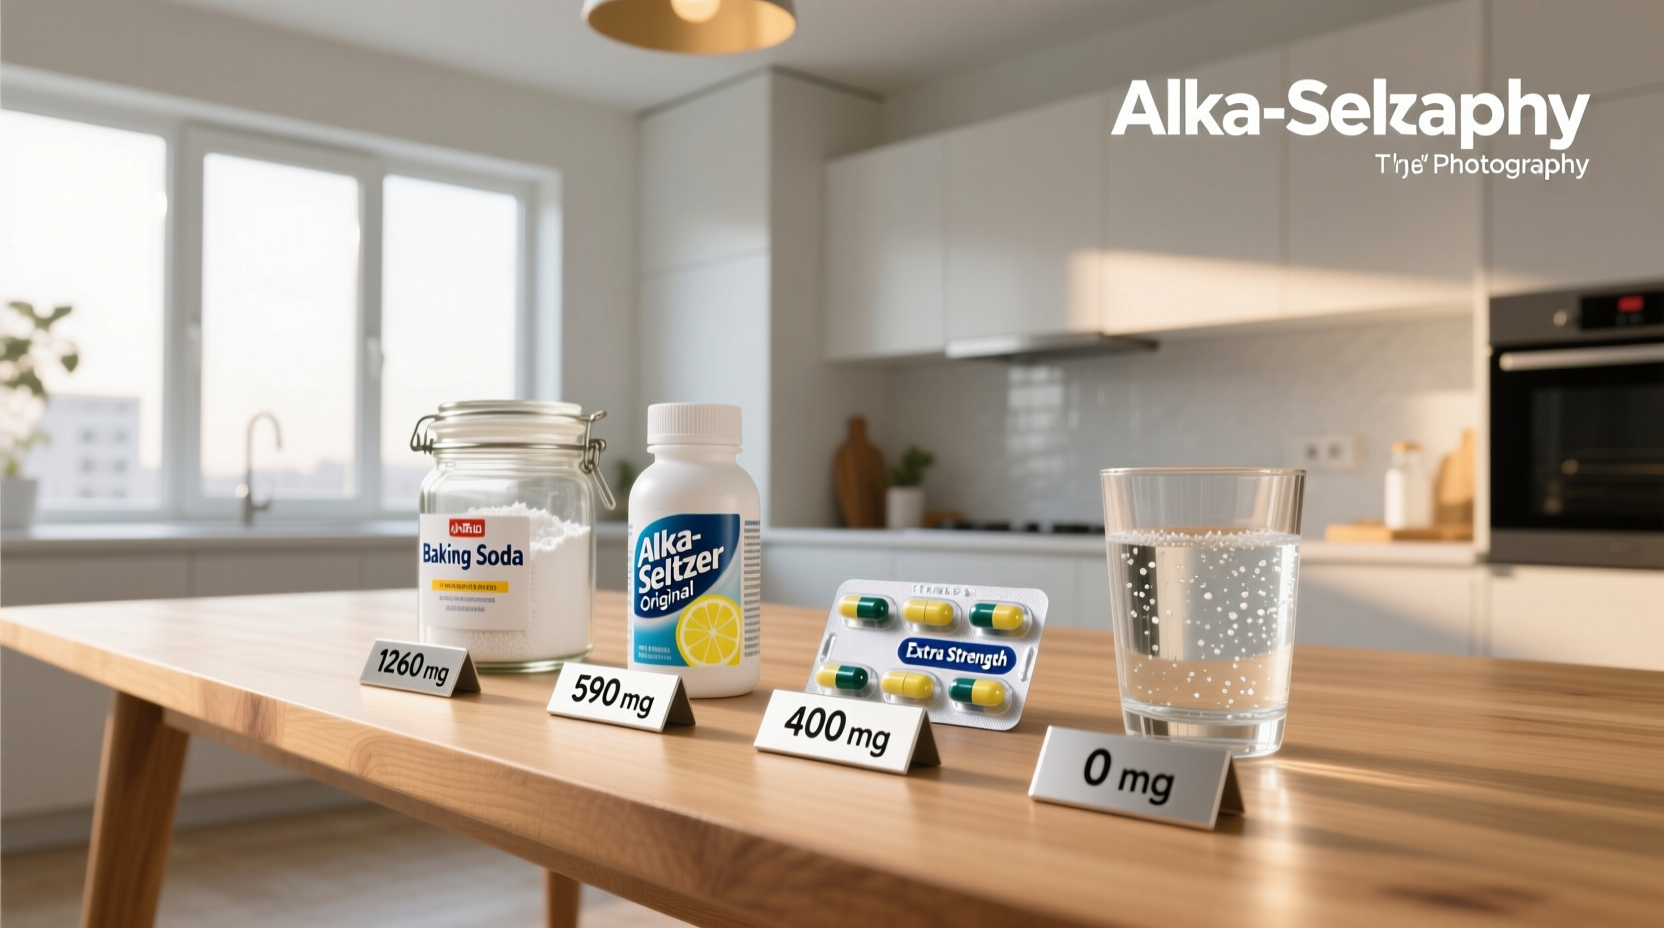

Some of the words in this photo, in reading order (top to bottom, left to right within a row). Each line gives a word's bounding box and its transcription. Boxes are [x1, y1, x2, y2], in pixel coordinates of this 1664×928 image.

[423, 542, 472, 571] Baking
[476, 543, 524, 567] Soda
[637, 529, 702, 568] Alka-
[638, 546, 725, 594] Seltzer
[640, 580, 694, 611] Original
[378, 648, 425, 677] 1260
[423, 665, 450, 687] mg
[906, 641, 944, 661] Extra
[946, 646, 1008, 670] Strength
[571, 674, 621, 706] 590
[619, 692, 655, 719] mg
[784, 705, 847, 742] 400
[847, 723, 891, 758] mg
[1083, 748, 1112, 786] 0
[1118, 768, 1175, 806] mg
